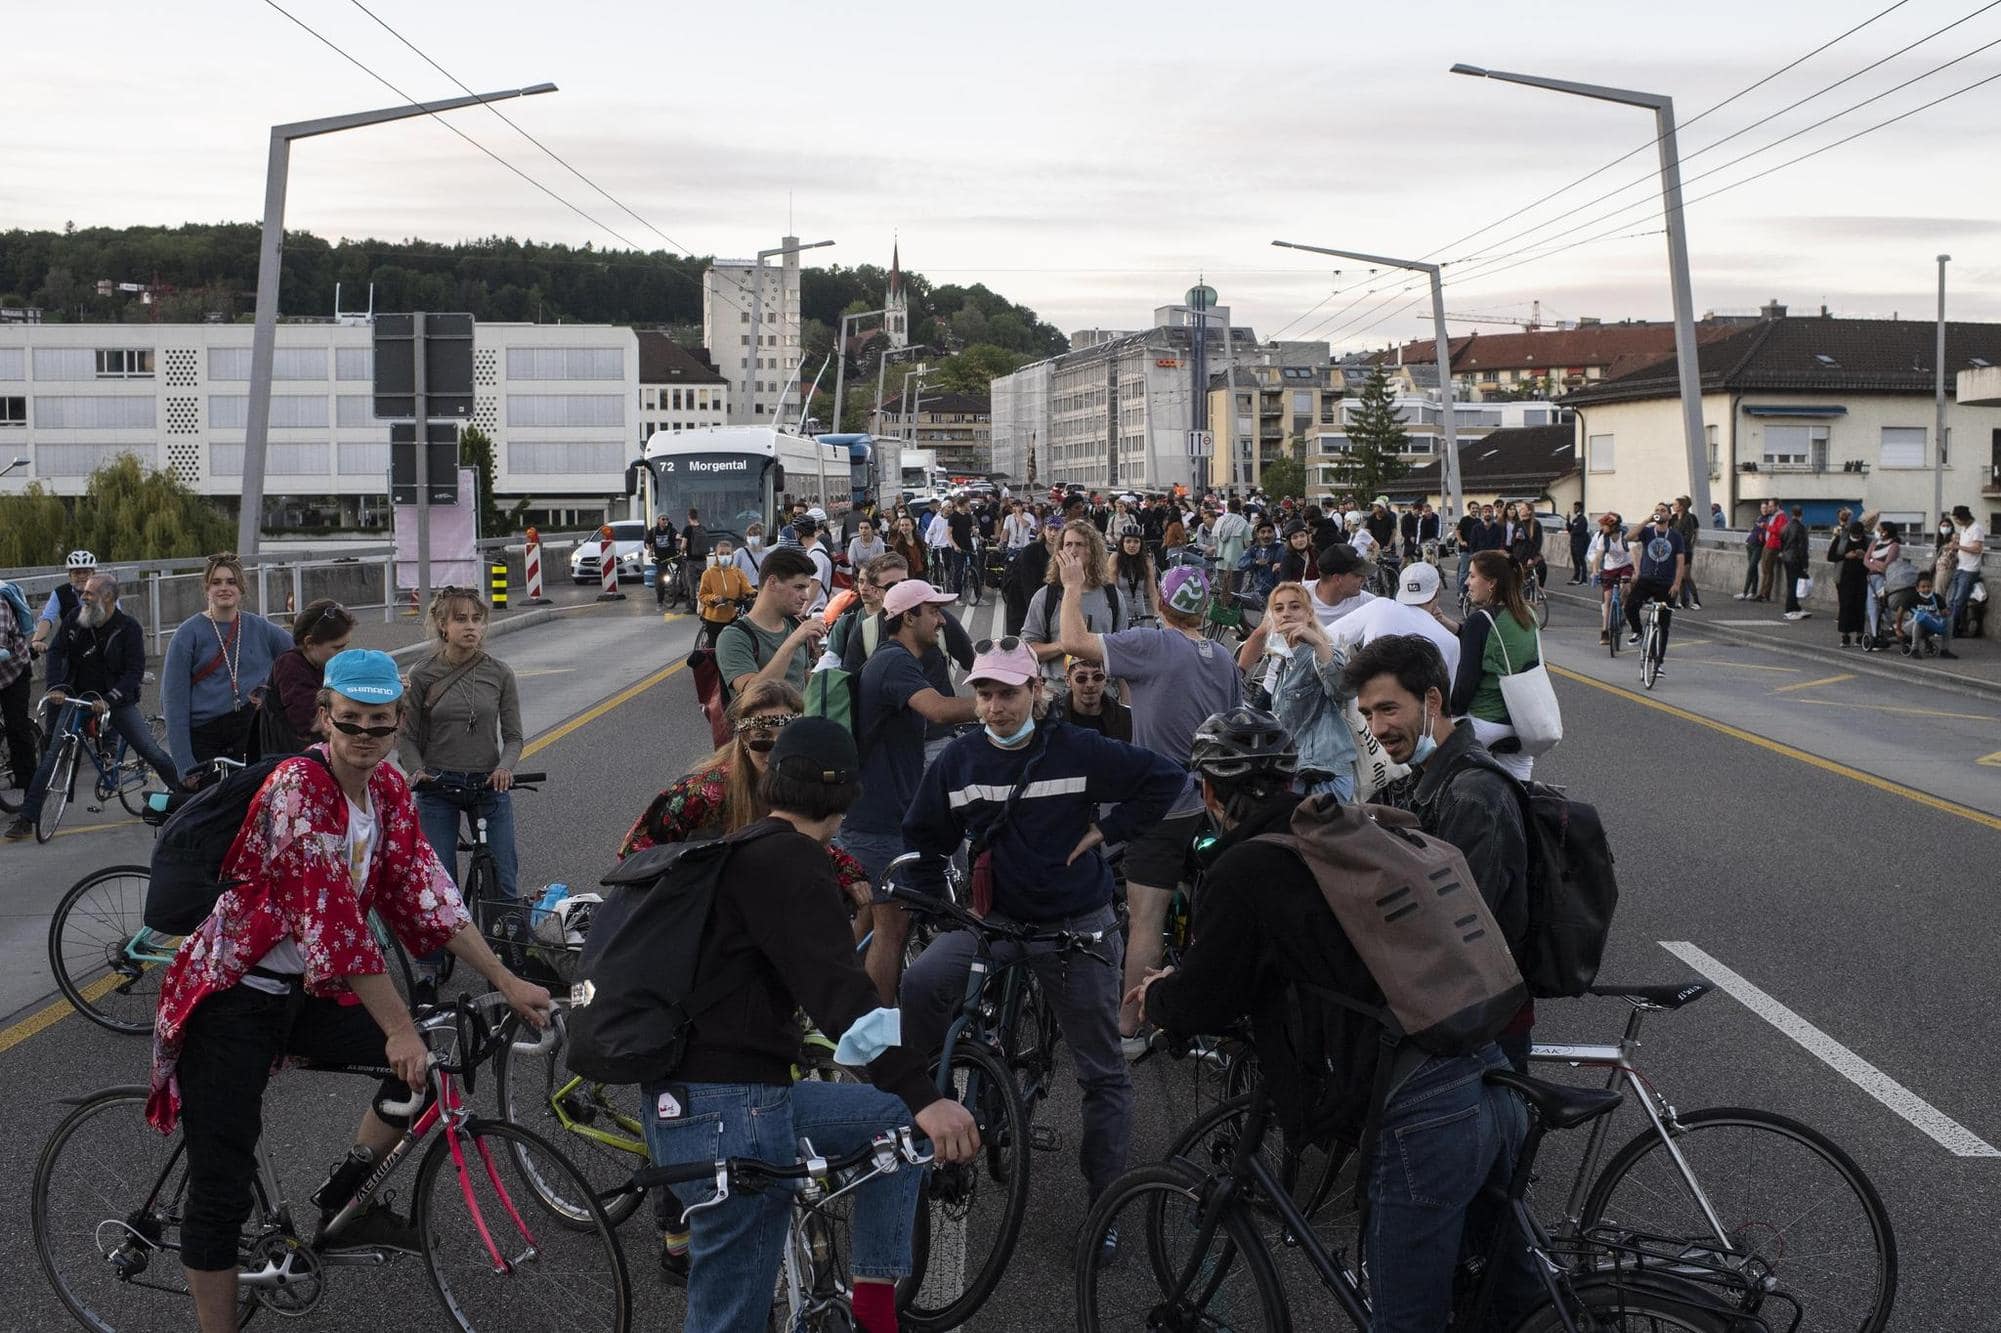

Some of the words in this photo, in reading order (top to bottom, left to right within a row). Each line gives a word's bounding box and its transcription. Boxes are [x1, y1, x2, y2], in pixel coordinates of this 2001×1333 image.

[659, 461, 675, 472] 72
[689, 460, 747, 472] Morgental
[1371, 759, 1388, 789] aby
[356, 1151, 401, 1203] MERIDA
